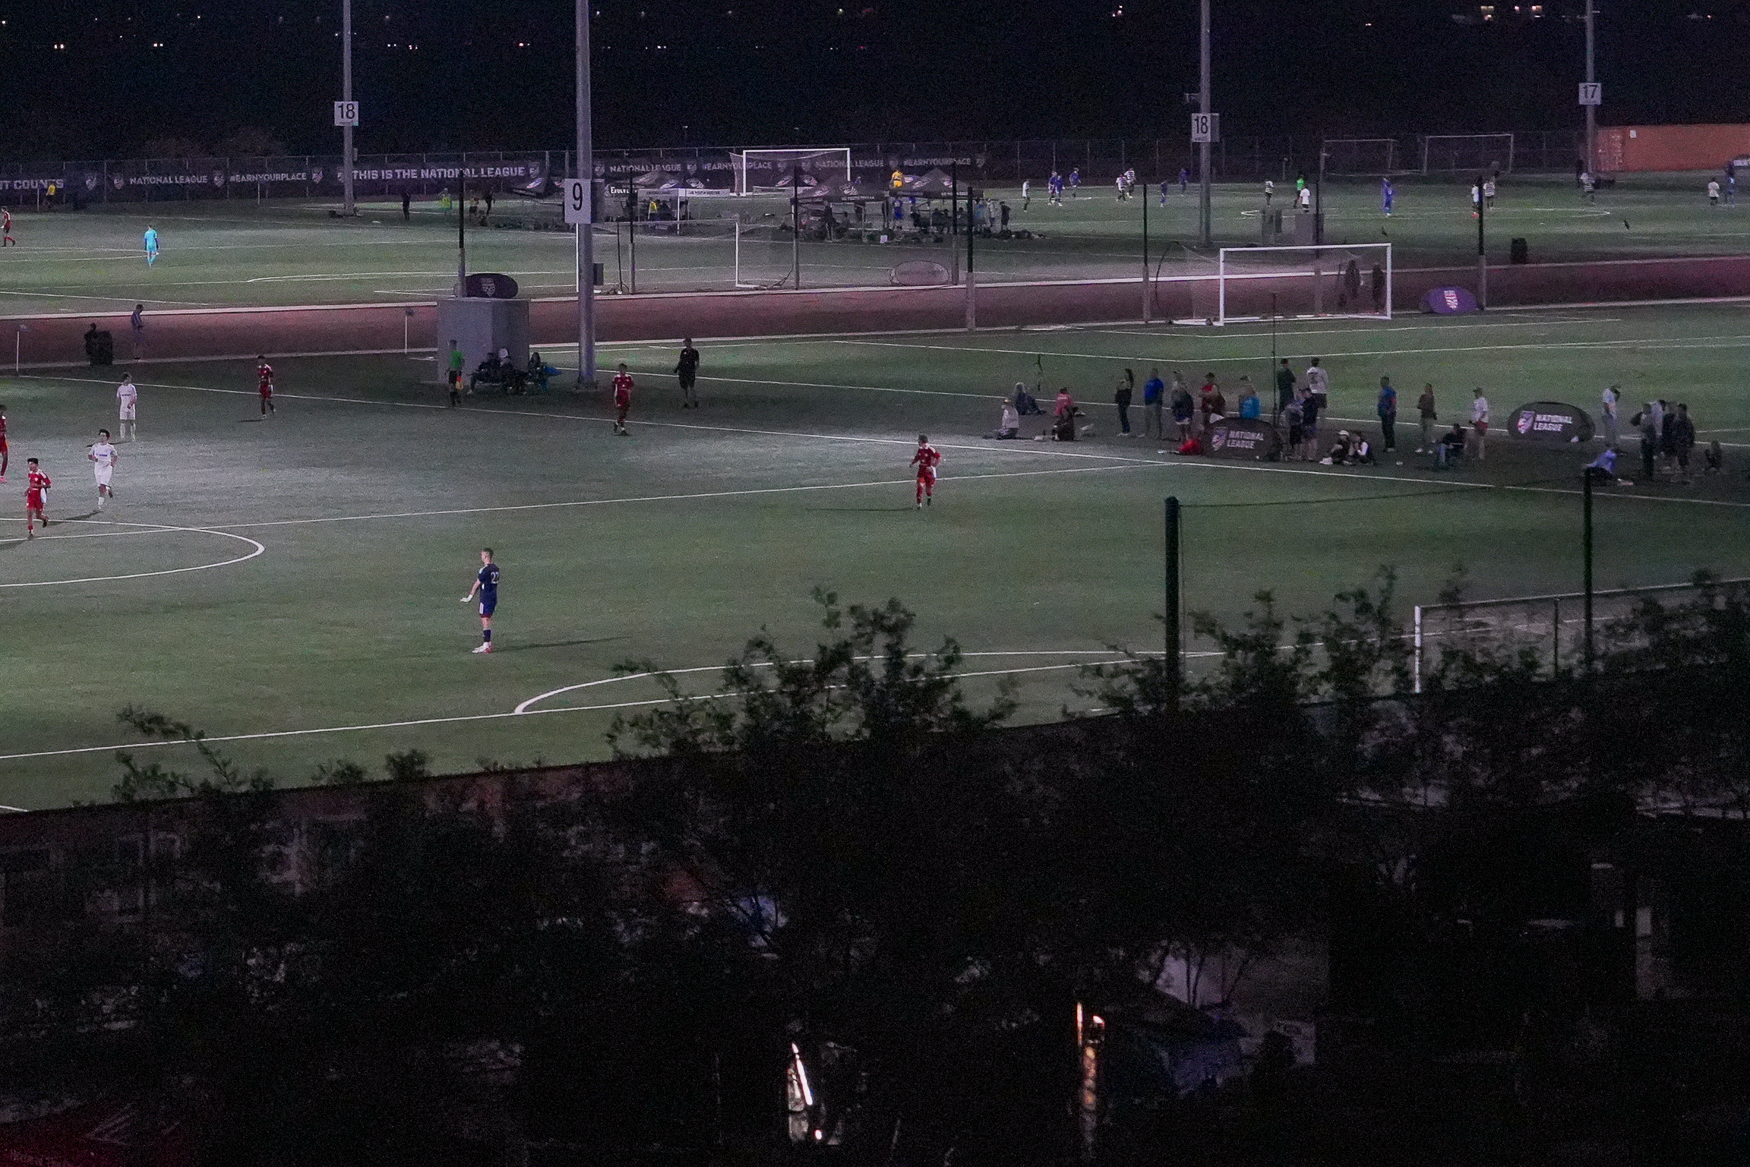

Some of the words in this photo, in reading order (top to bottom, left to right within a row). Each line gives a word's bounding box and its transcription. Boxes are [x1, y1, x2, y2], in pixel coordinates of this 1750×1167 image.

[1583, 84, 1597, 99] 17
[337, 103, 355, 120] 18
[1194, 116, 1208, 135] 18
[815, 160, 854, 170] NATIONL
[175, 175, 208, 185] LEAGUE
[352, 169, 379, 180] THIS
[381, 169, 393, 180] IS
[395, 168, 418, 180] THE
[480, 166, 526, 178] LEAGUE
[572, 181, 582, 212] 9
[1535, 413, 1573, 425] NATIONAL
[1532, 422, 1563, 432] LEAGUE
